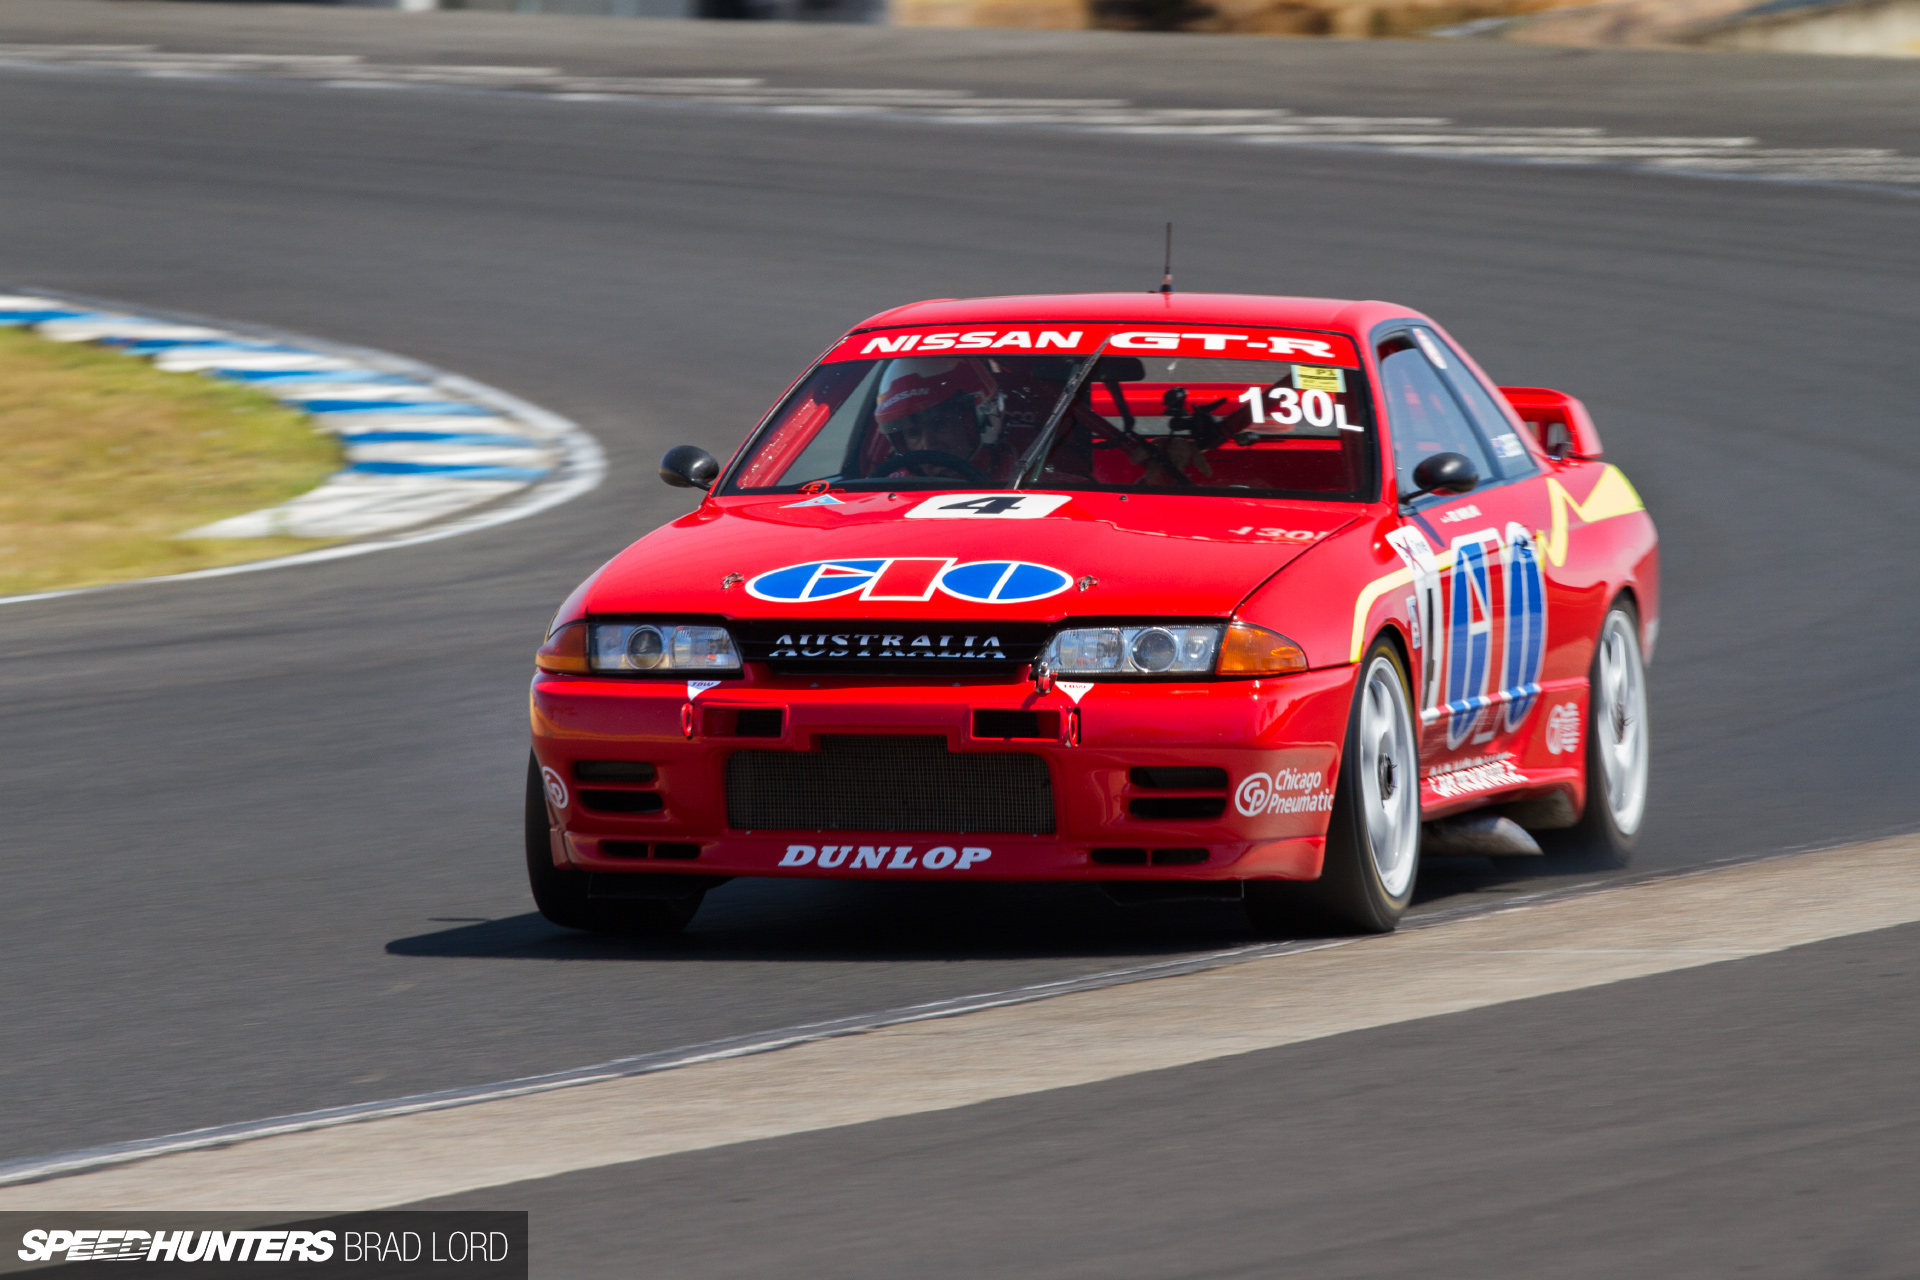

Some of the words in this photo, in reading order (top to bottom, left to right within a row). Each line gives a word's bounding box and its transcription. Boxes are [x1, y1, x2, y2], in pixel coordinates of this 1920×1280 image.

[860, 331, 1083, 354] NISSAN
[1110, 332, 1335, 358] GT-R
[883, 387, 930, 407] NISSAN
[938, 496, 1027, 515] 4
[769, 634, 1006, 658] AUSTRALIA
[1275, 768, 1322, 794] Chicago
[1267, 788, 1334, 814] Pneumatic
[778, 845, 992, 869] DUNLOP
